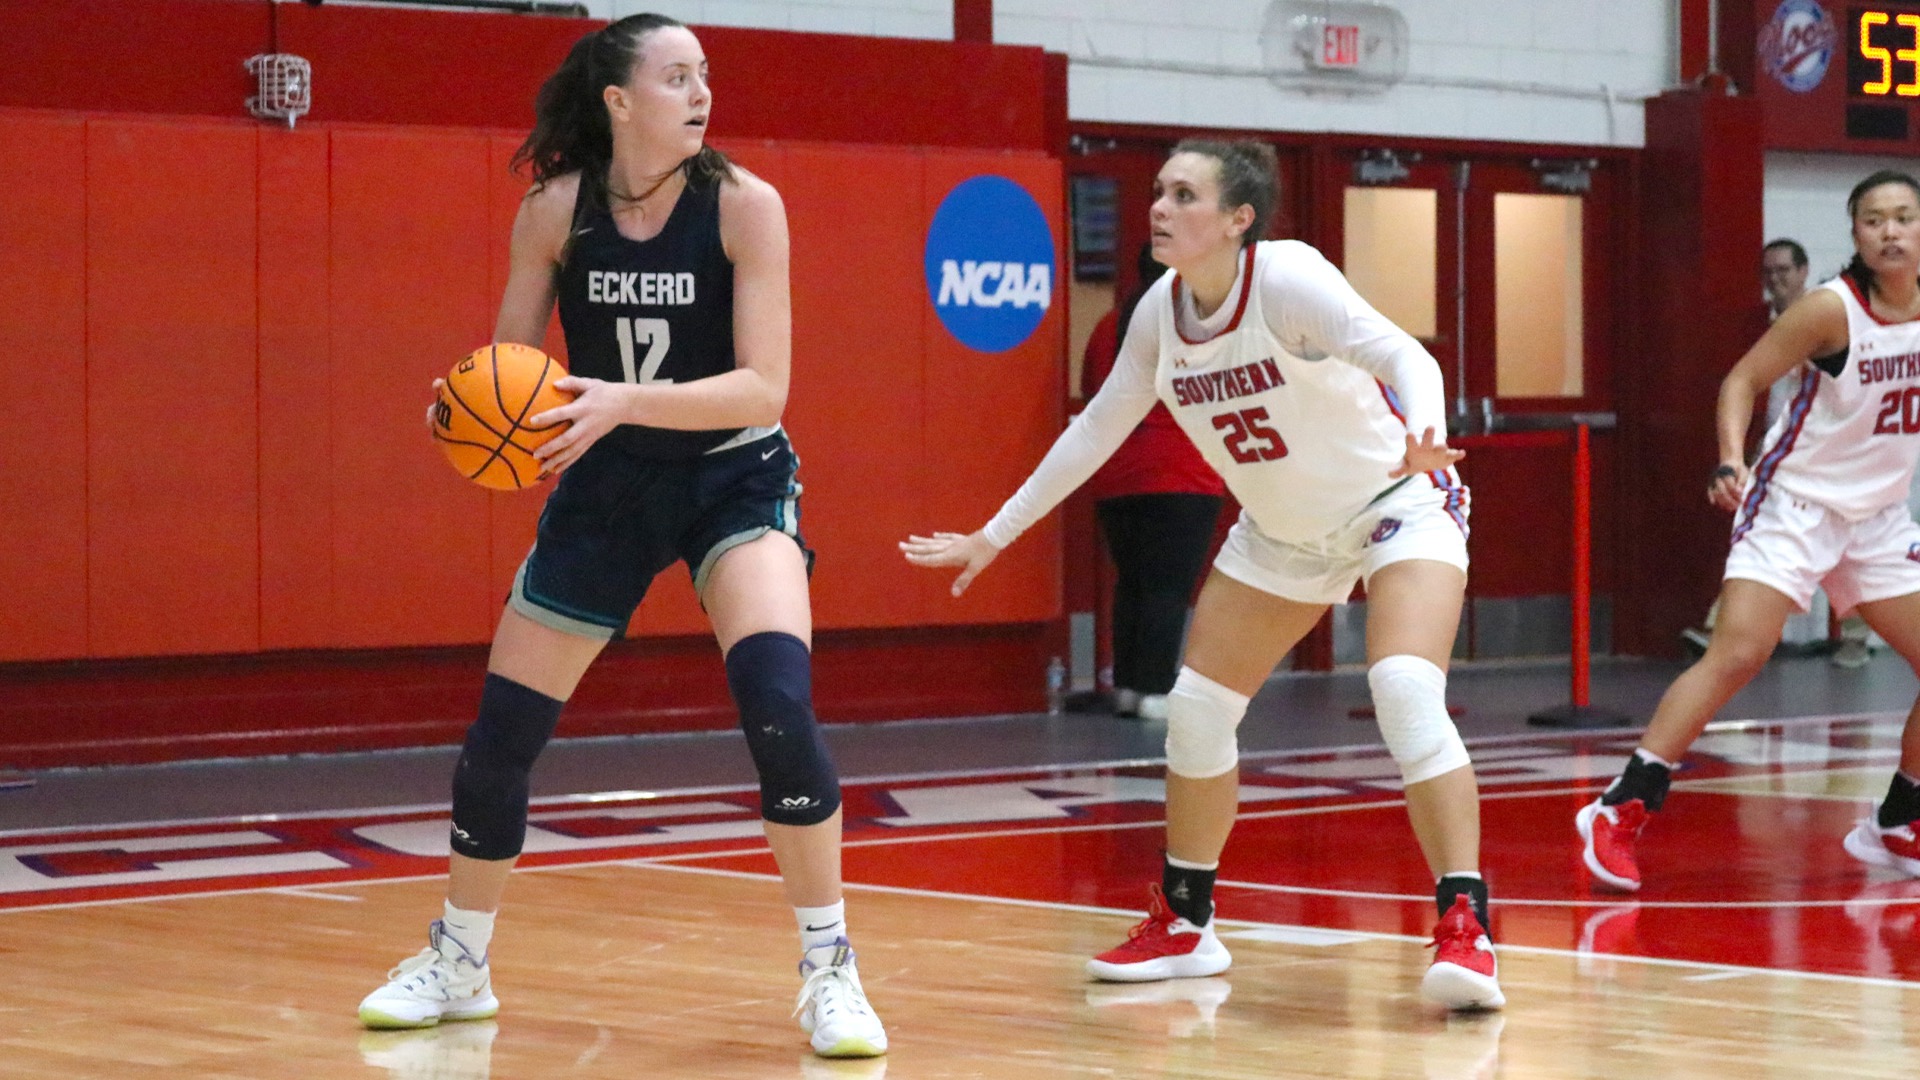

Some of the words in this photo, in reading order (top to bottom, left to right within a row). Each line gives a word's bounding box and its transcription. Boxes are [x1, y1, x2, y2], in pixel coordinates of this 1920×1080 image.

[1324, 25, 1358, 64] EXIT
[1860, 11, 1920, 96] 53
[588, 270, 696, 306] ECKERD
[937, 259, 1051, 309] NCAA
[616, 317, 673, 384] 12
[1858, 352, 1920, 386] SOUTH
[1172, 357, 1286, 407] SOUTHERN
[1212, 406, 1289, 464] 25
[1873, 387, 1920, 434] 20
